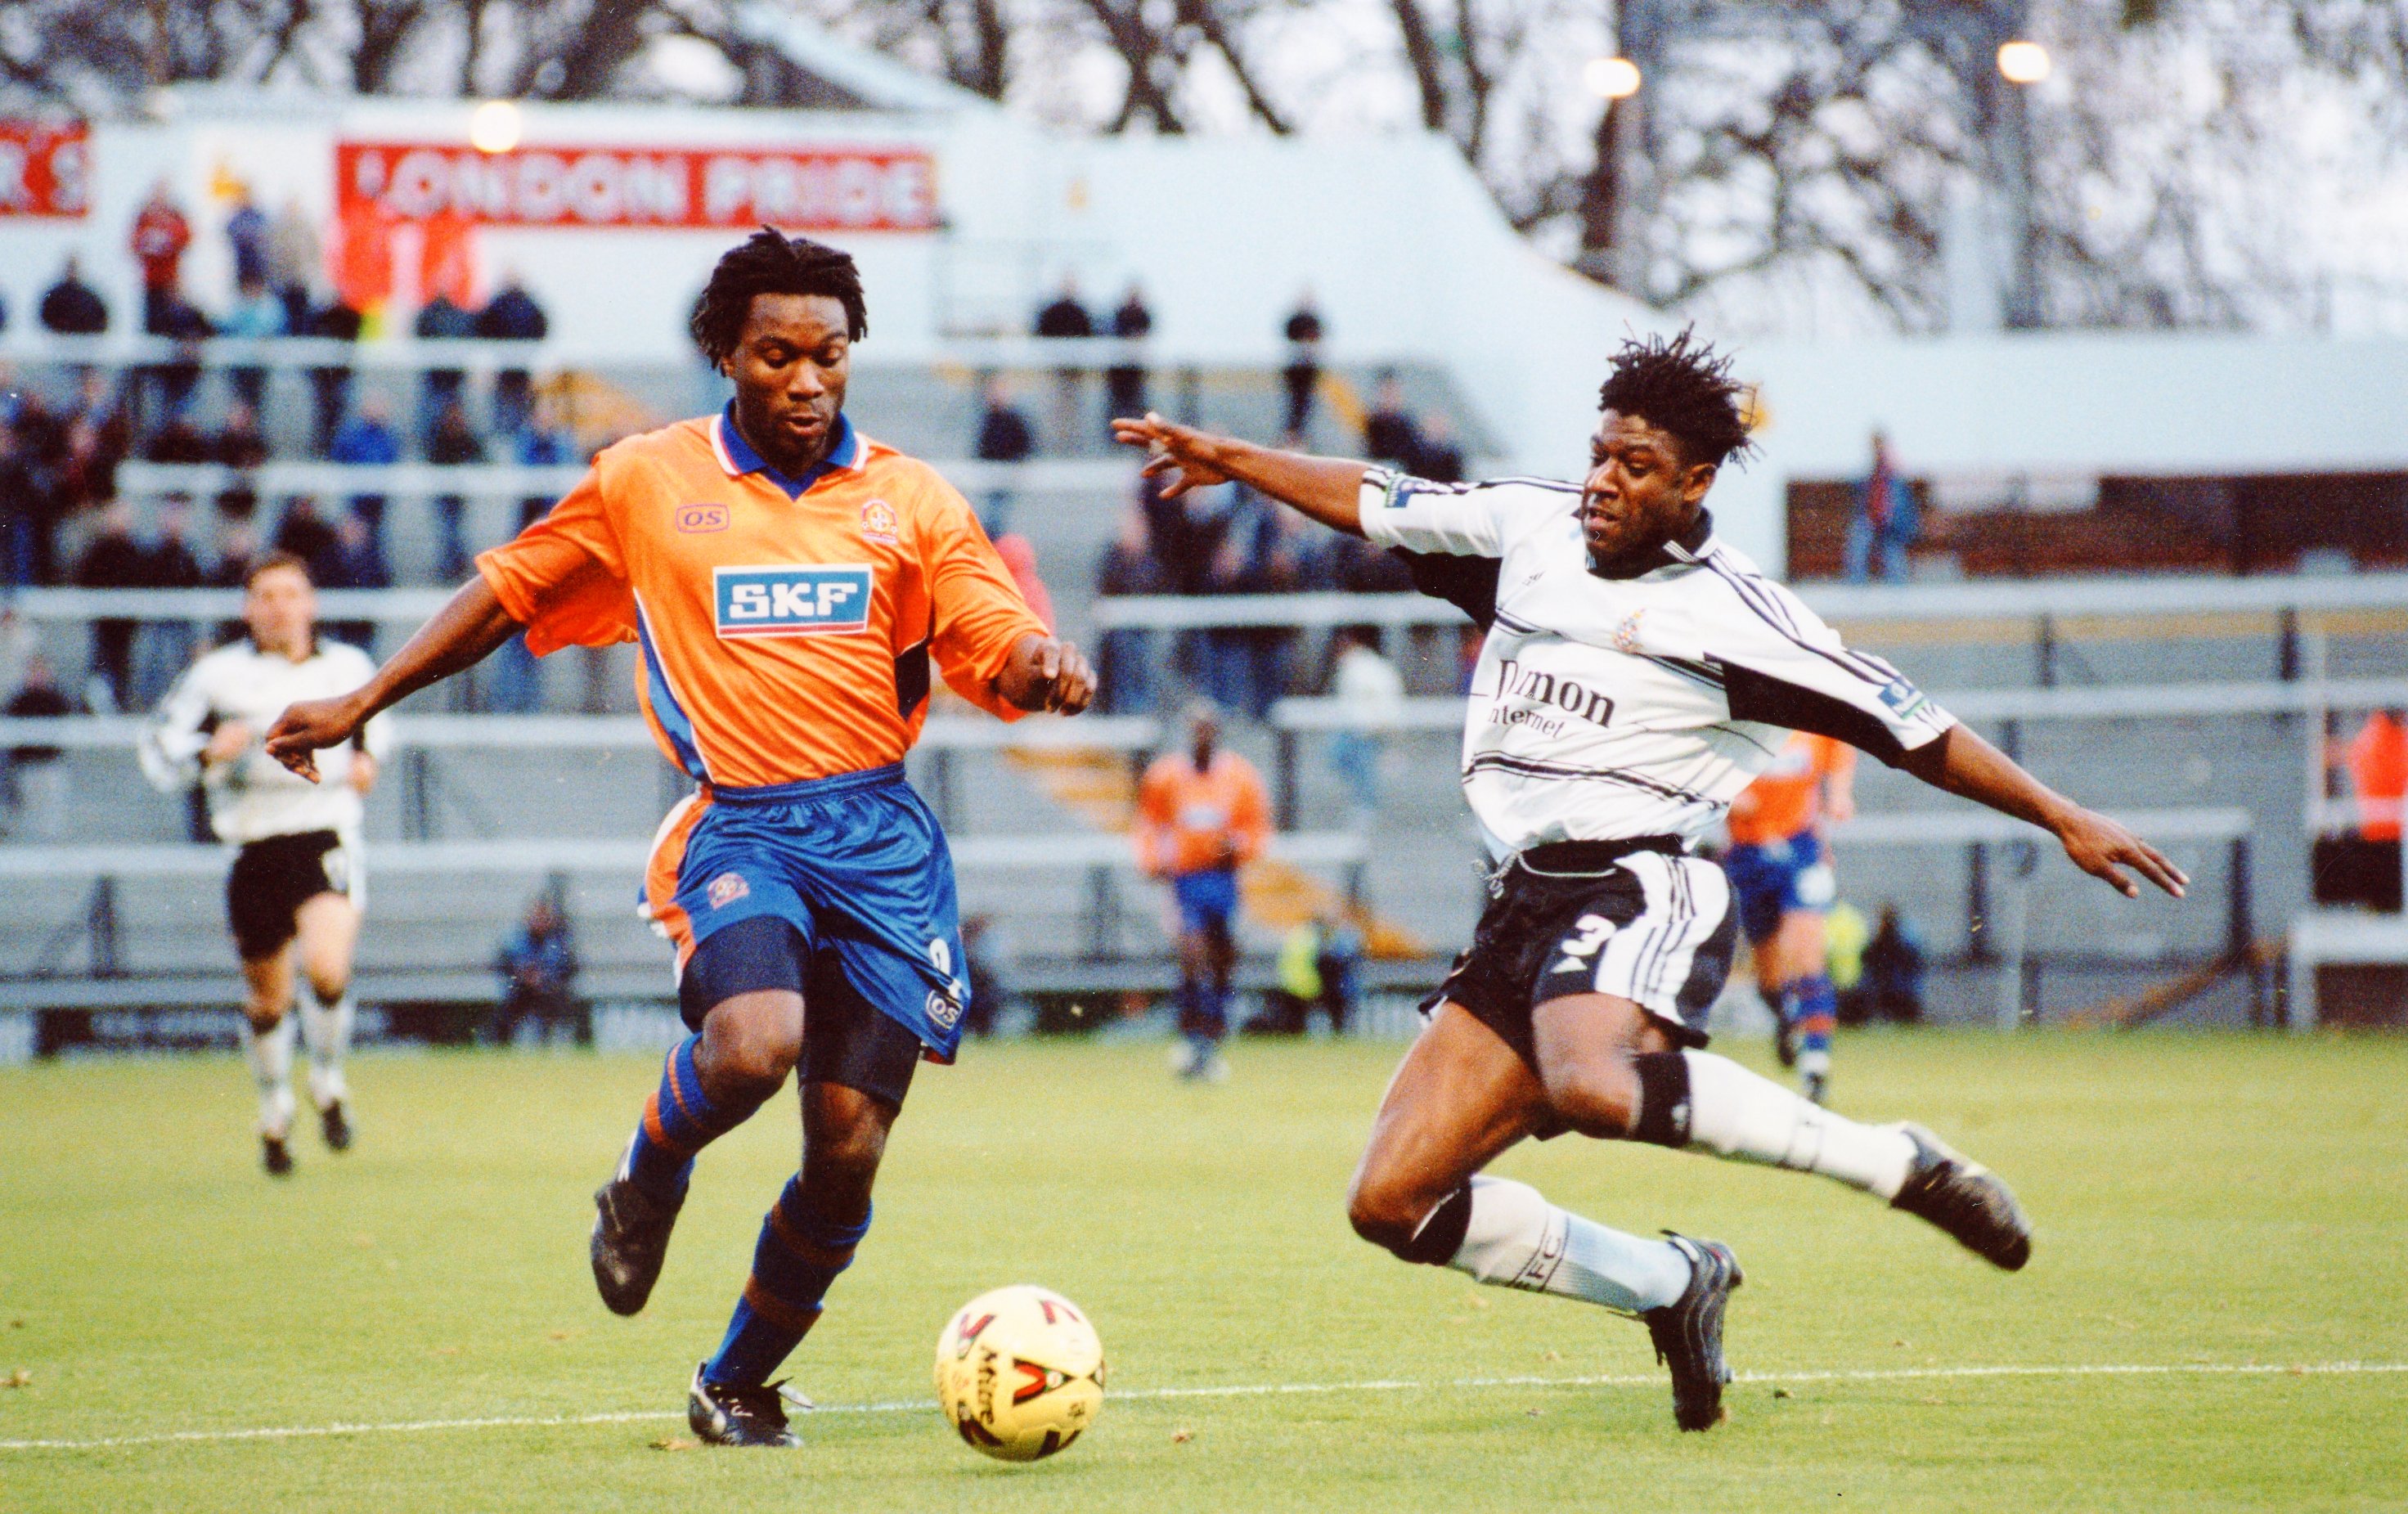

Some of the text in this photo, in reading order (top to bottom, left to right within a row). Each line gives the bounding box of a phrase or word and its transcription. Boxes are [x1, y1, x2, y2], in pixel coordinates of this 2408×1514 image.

[709, 155, 936, 223] PRIDE
[683, 510, 722, 527] OS
[729, 582, 858, 619] SKF
[1487, 703, 1566, 739] nternet
[931, 998, 959, 1023] OS
